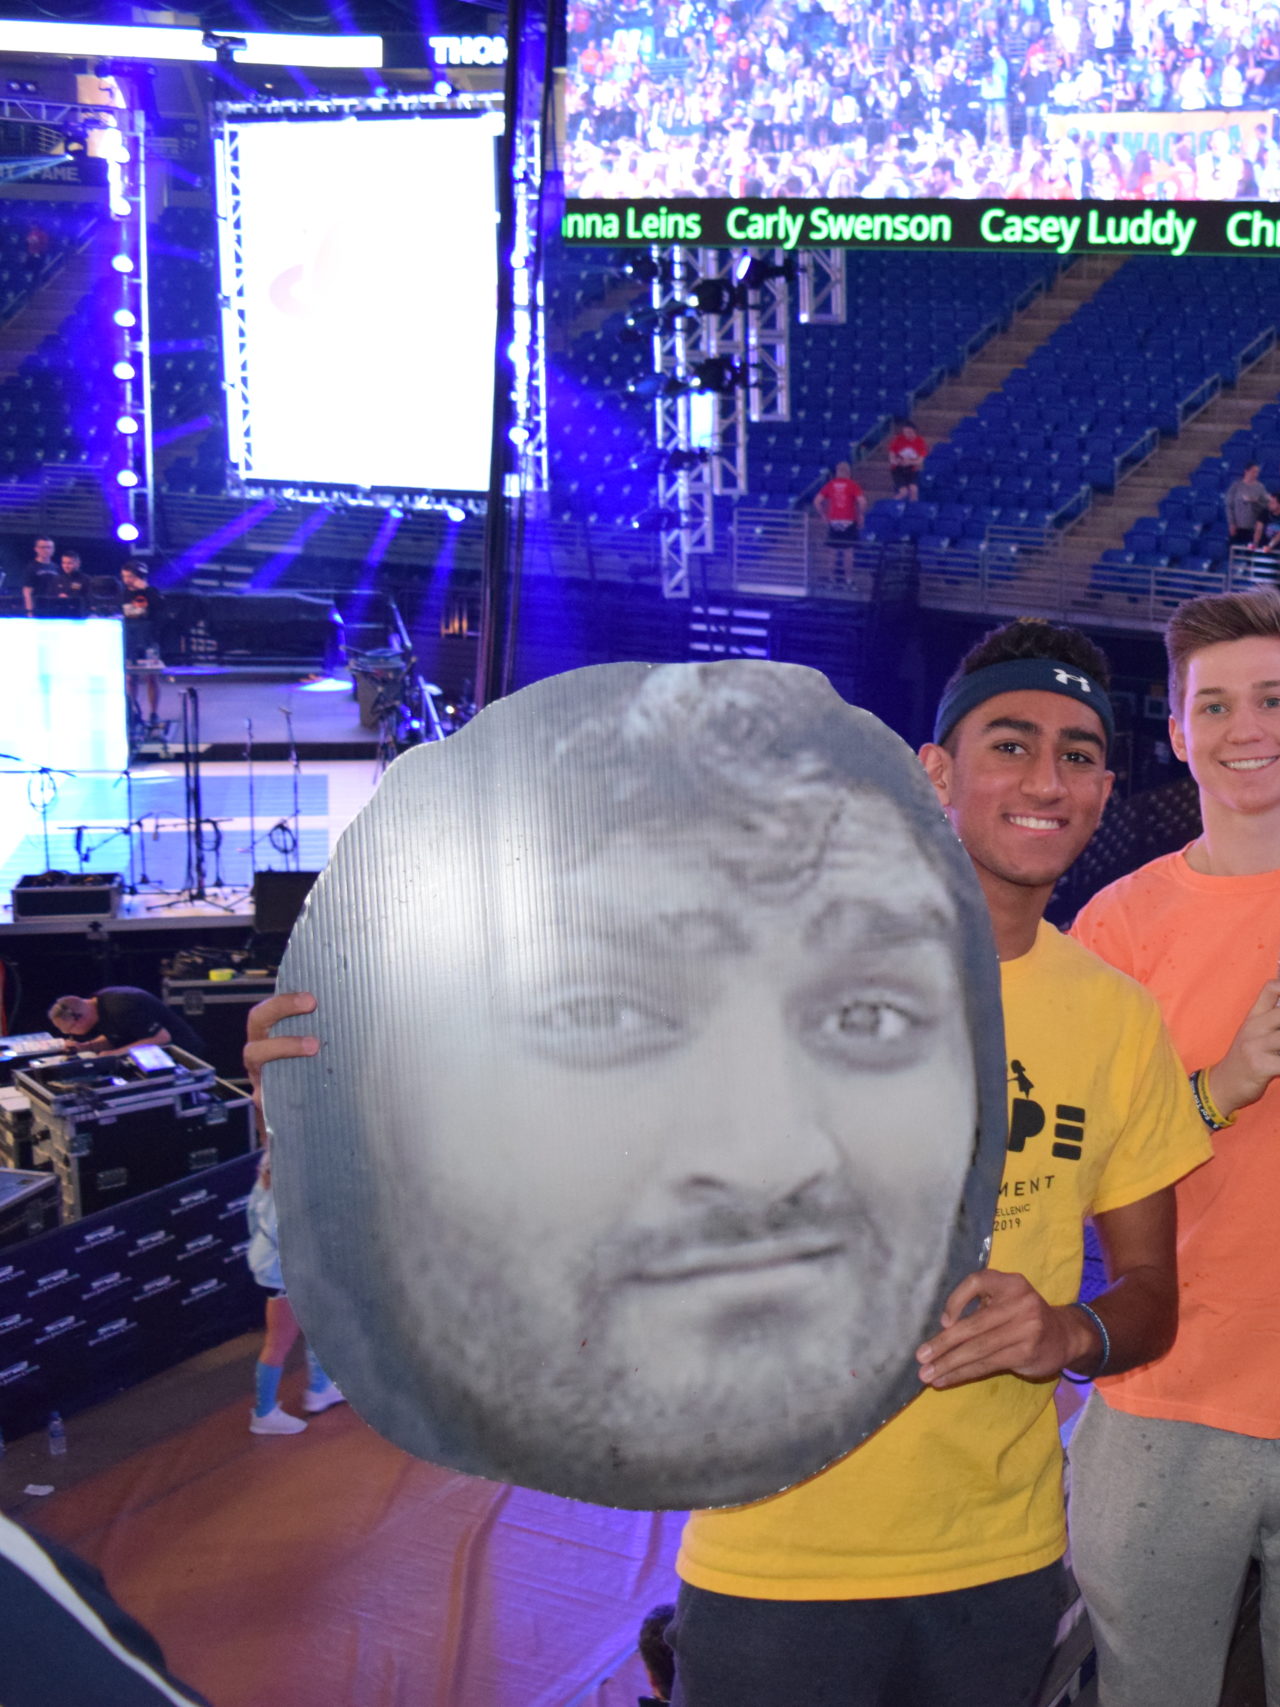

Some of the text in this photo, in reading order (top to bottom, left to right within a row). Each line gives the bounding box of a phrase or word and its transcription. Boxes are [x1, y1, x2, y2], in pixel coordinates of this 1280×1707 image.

[626, 206, 702, 240] Leins
[726, 206, 804, 250] Carly
[809, 207, 953, 242] Swenson
[980, 208, 1081, 254] Casey
[1086, 209, 1197, 256] Luddy
[993, 1217, 1021, 1232] 2019
